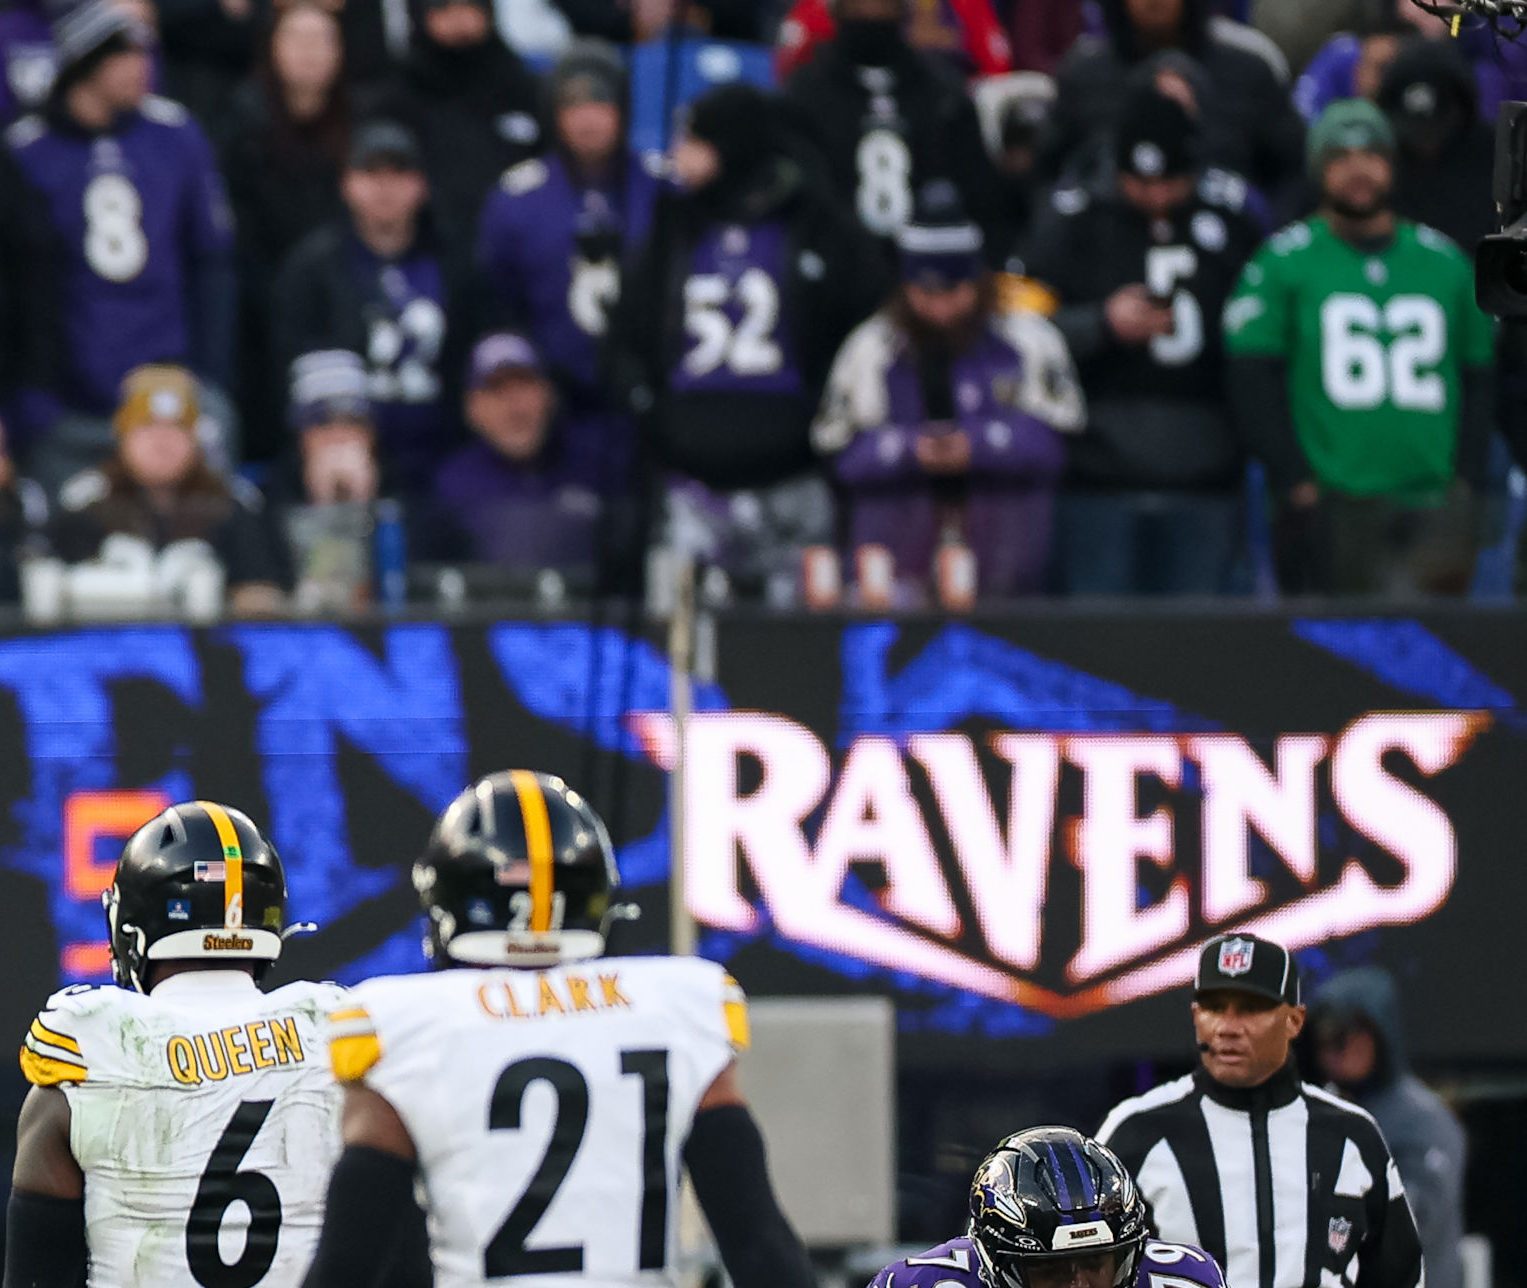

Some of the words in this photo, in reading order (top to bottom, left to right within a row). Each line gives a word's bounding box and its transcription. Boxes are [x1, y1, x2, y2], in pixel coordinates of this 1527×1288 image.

[83, 174, 147, 283] 8
[857, 130, 912, 235] 8
[684, 268, 783, 377] 52
[1147, 245, 1203, 364] 5
[1319, 291, 1448, 413] 62
[225, 892, 243, 930] 6
[627, 708, 1493, 1016] RAVENS
[203, 934, 254, 951] Steelers
[476, 968, 633, 1019] CLARK
[167, 1016, 305, 1087] QUEEN
[484, 1048, 671, 1279] 21
